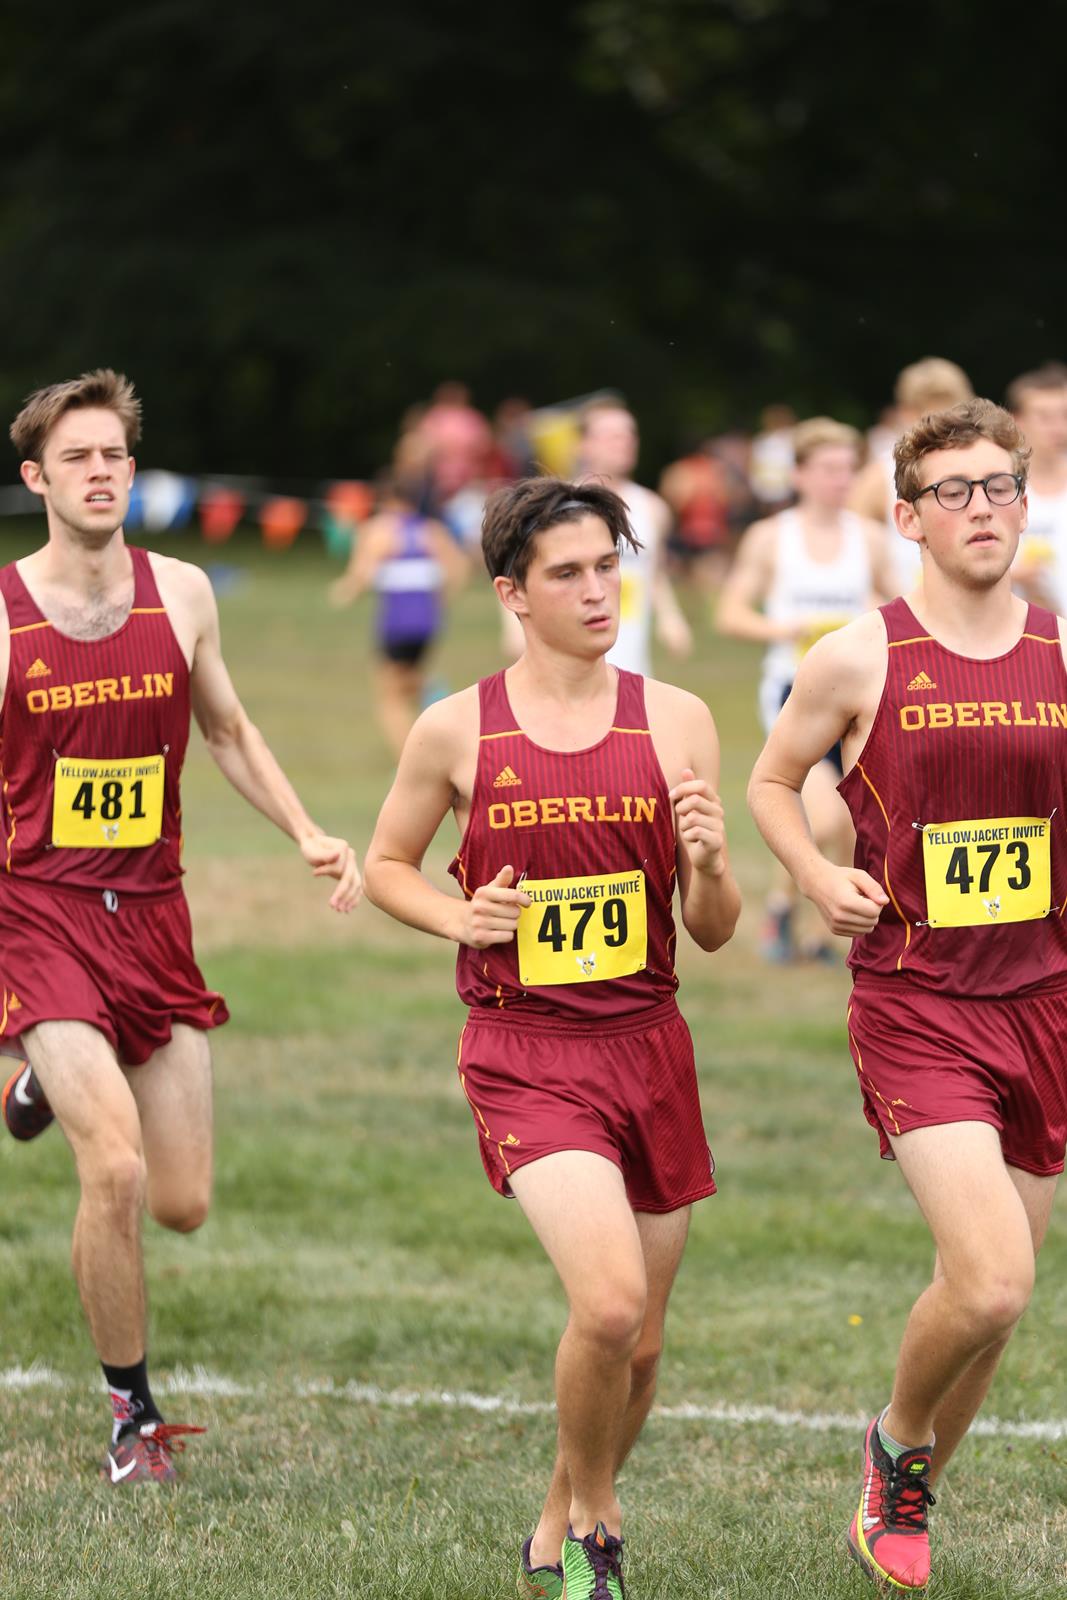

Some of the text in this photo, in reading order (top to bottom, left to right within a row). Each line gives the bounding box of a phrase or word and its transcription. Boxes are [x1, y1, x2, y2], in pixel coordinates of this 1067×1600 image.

[26, 672, 174, 714] OBERLIN
[907, 682, 937, 691] adidas
[900, 701, 1067, 731] OBERLIN
[61, 762, 160, 778] YELLOWJACKET INVITE
[493, 778, 522, 788] adidas
[71, 780, 146, 820] 481
[488, 796, 657, 829] OBERLIN
[928, 824, 1045, 845] YELLOWJACKET INVITE
[945, 841, 1031, 894] 473
[520, 880, 640, 903] ELLOWJACKET INVITE
[537, 898, 629, 952] 479
